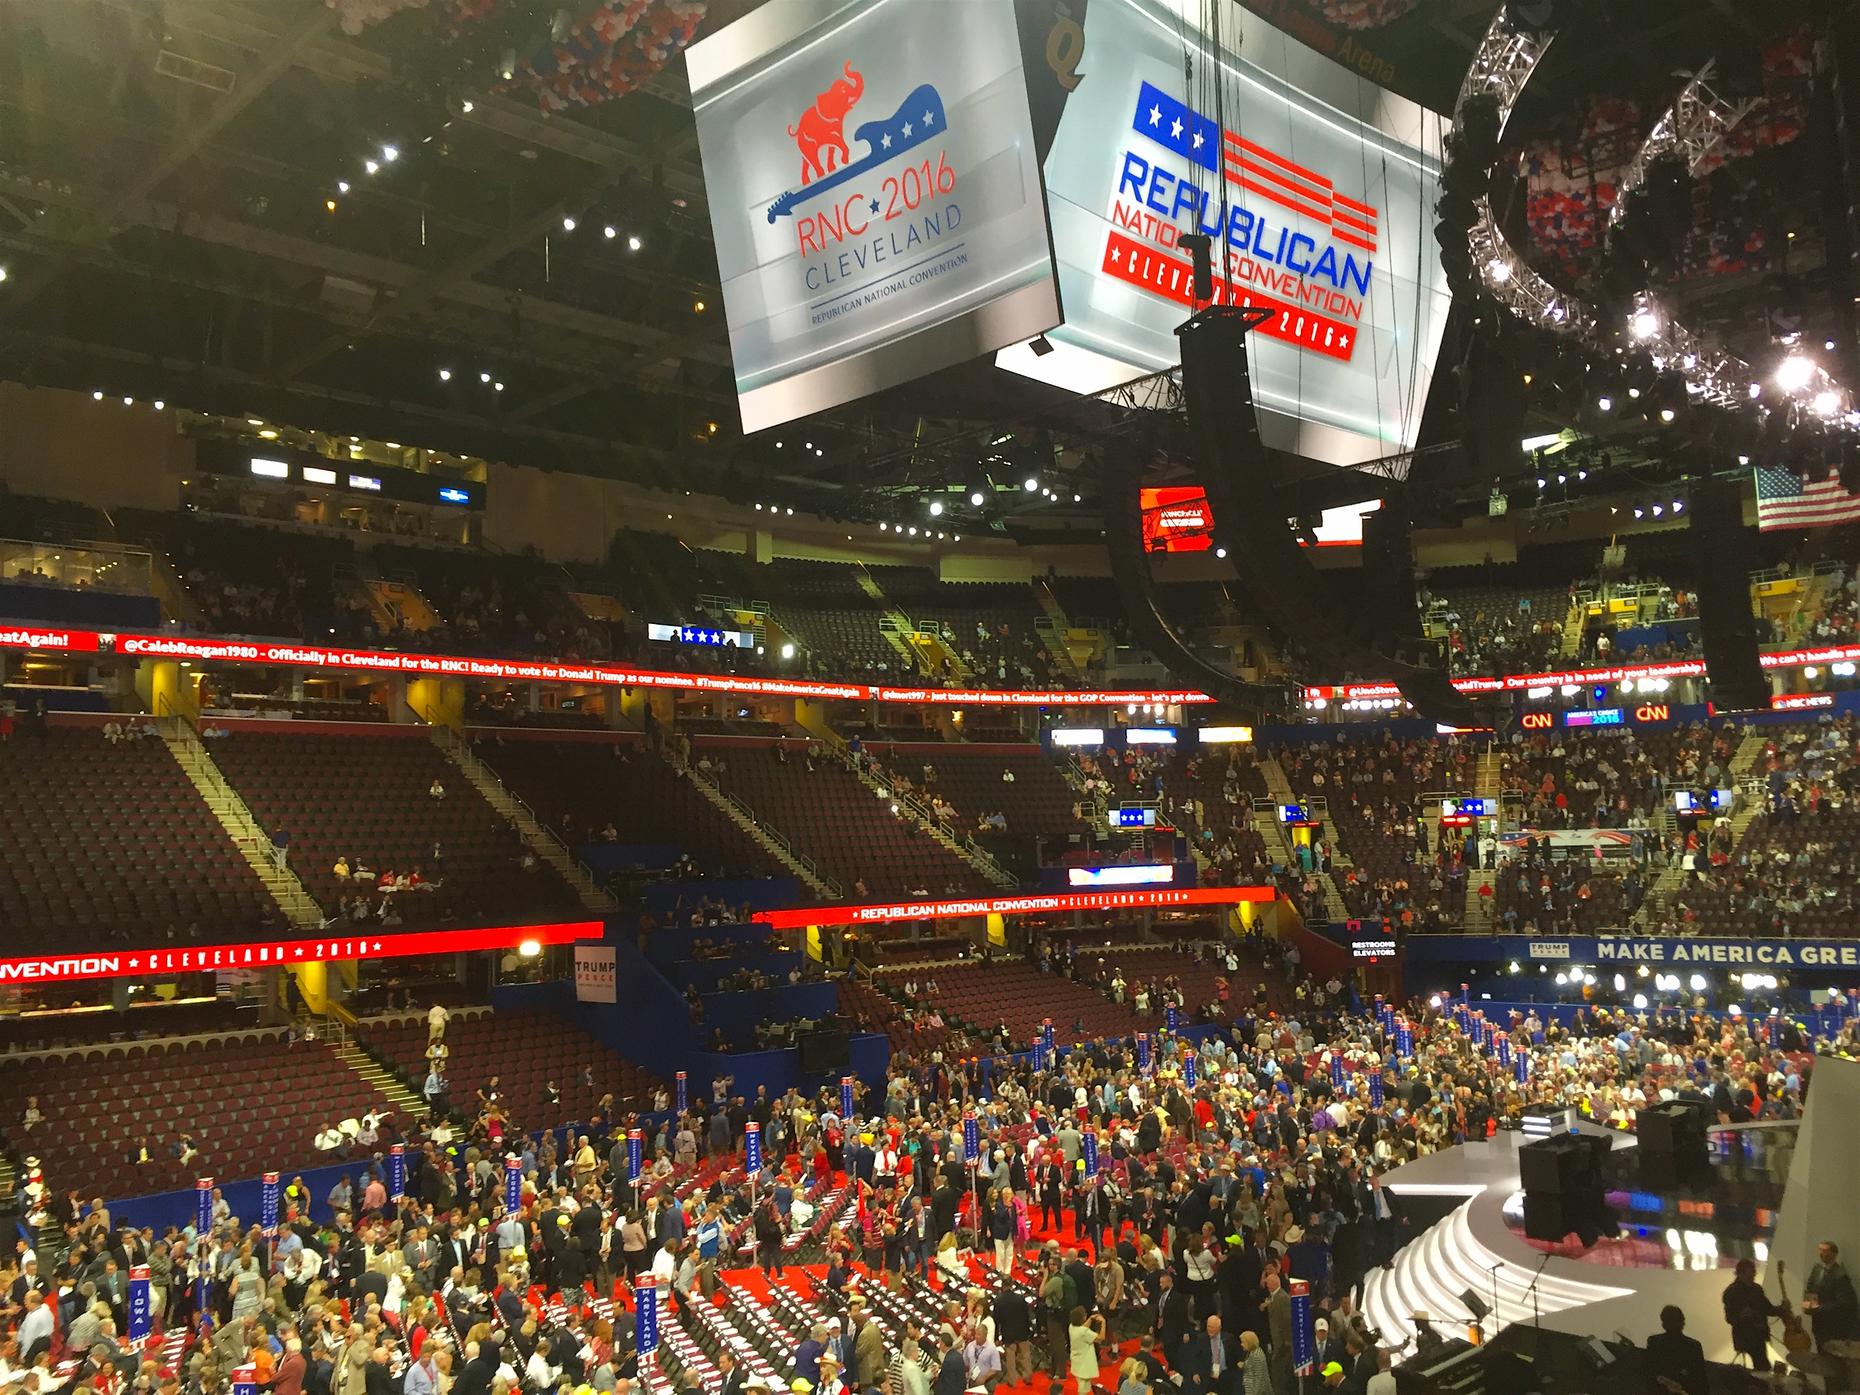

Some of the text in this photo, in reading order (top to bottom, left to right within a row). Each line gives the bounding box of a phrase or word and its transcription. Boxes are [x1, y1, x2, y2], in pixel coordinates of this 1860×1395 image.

[1046, 17, 1085, 93] Q
[1337, 35, 1396, 83] Arena
[797, 150, 956, 258] RNC 2016
[1119, 150, 1373, 297] REPUBLICAN
[805, 203, 962, 291] CLEVELAND
[1112, 199, 1363, 321] NATIO CONVENTION
[811, 253, 968, 326] REPUBLICAN NATIONAL CONVENTION
[1128, 250, 1334, 348] CLEVEAND 2016
[124, 639, 258, 658] @CalebReagan1980
[268, 648, 326, 665] Officially
[327, 652, 340, 663] in
[341, 653, 400, 667] Cleveland
[402, 656, 420, 669] for
[420, 657, 439, 670] the
[441, 659, 469, 672] RNC!
[471, 663, 503, 676] Ready
[504, 666, 517, 675] to
[518, 666, 541, 677] vote
[542, 667, 558, 678] for
[559, 668, 594, 680] Donald
[595, 671, 626, 684] Trump
[627, 674, 637, 683] as
[638, 675, 655, 684] our
[655, 675, 695, 686] nominee.
[1760, 655, 1777, 665] We
[1011, 693, 1050, 702] Cleveland
[1050, 693, 1063, 702] for
[1064, 694, 1078, 702] the
[1079, 693, 1099, 702] GOP
[1099, 693, 1145, 702] Convention
[1507, 678, 1526, 687] Our
[1527, 674, 1565, 688] country
[1636, 705, 1668, 721] CNN
[1807, 696, 1833, 707] NEWS
[1522, 713, 1552, 728] CNN
[860, 892, 1179, 919] REPUBLICAN NATIONAL CONVENTION CLEVELAND 2016
[0, 941, 367, 979] VENTION CLEVELAND 2016
[1352, 940, 1395, 949] RESTROOMS
[1353, 949, 1395, 957] ELEVATORS
[1597, 943, 1860, 965] MAKE AMERICA GRE
[576, 961, 615, 972] TRUMP
[134, 1289, 144, 1324] IOWA
[642, 1289, 651, 1347] MARYLAND
